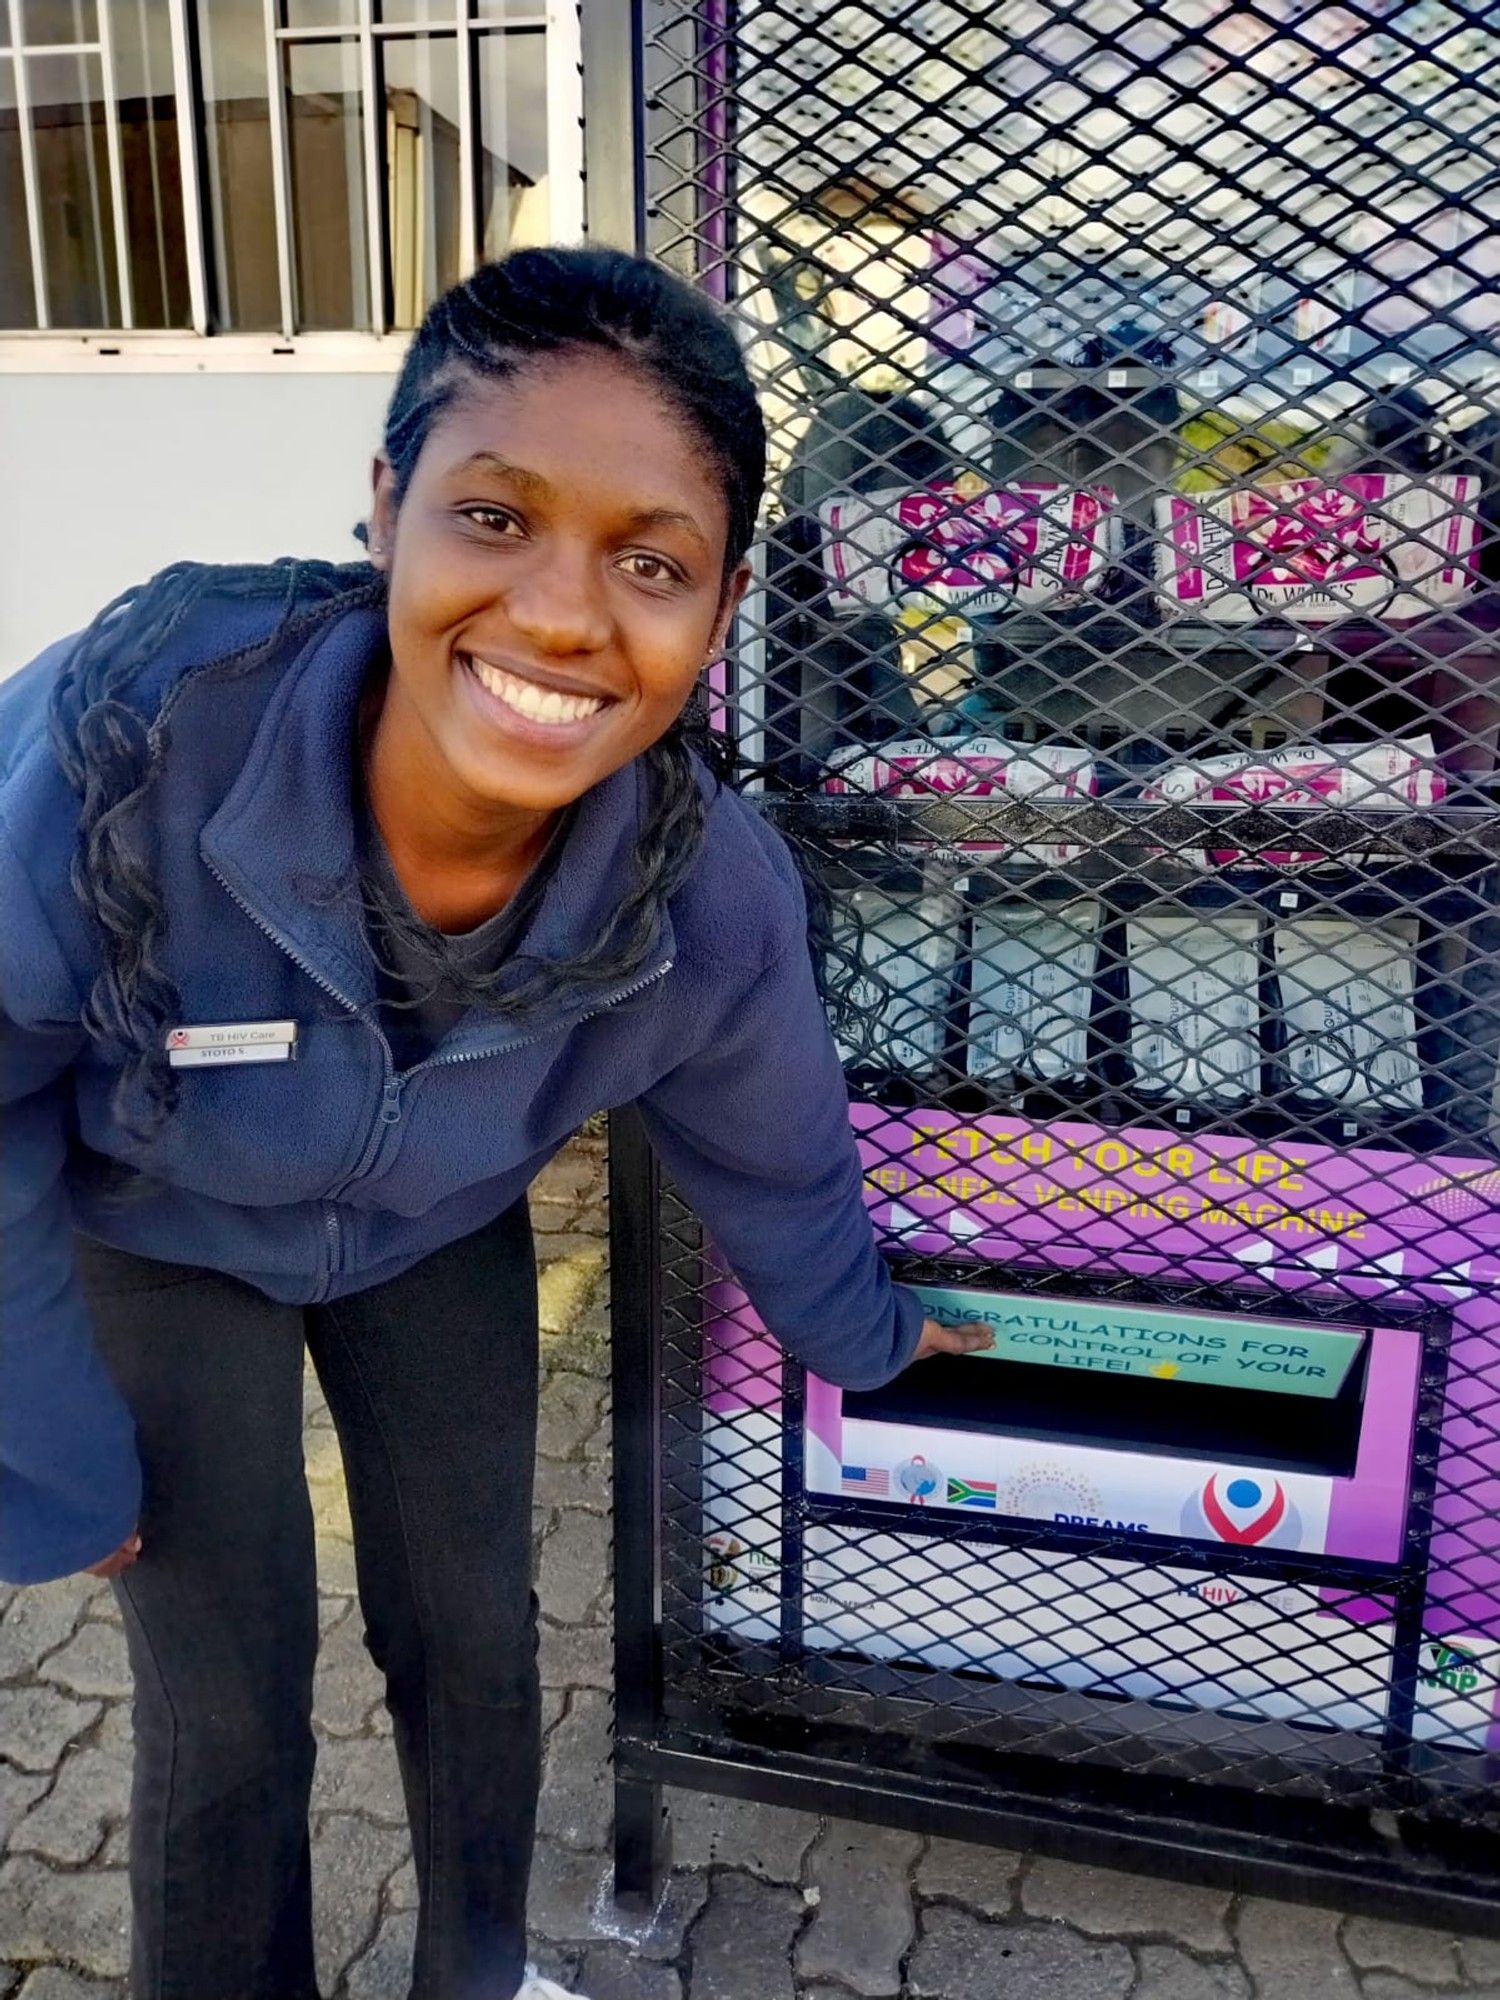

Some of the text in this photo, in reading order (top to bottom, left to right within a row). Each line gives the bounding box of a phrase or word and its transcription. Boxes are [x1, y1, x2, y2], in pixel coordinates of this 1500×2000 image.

[901, 742, 962, 755] ITE'S
[227, 1031, 248, 1041] HIV
[250, 1031, 275, 1040] Care
[911, 1126, 1308, 1191] FETCH YOUR LIFE
[1034, 1183, 1191, 1219] VENDING
[1201, 1199, 1366, 1239] MACHINE
[921, 1303, 1309, 1359] ONGRATULATIONS FOR
[1010, 1332, 1327, 1378] CONTROL OF YOUR
[1053, 1353, 1131, 1371] LIFE!
